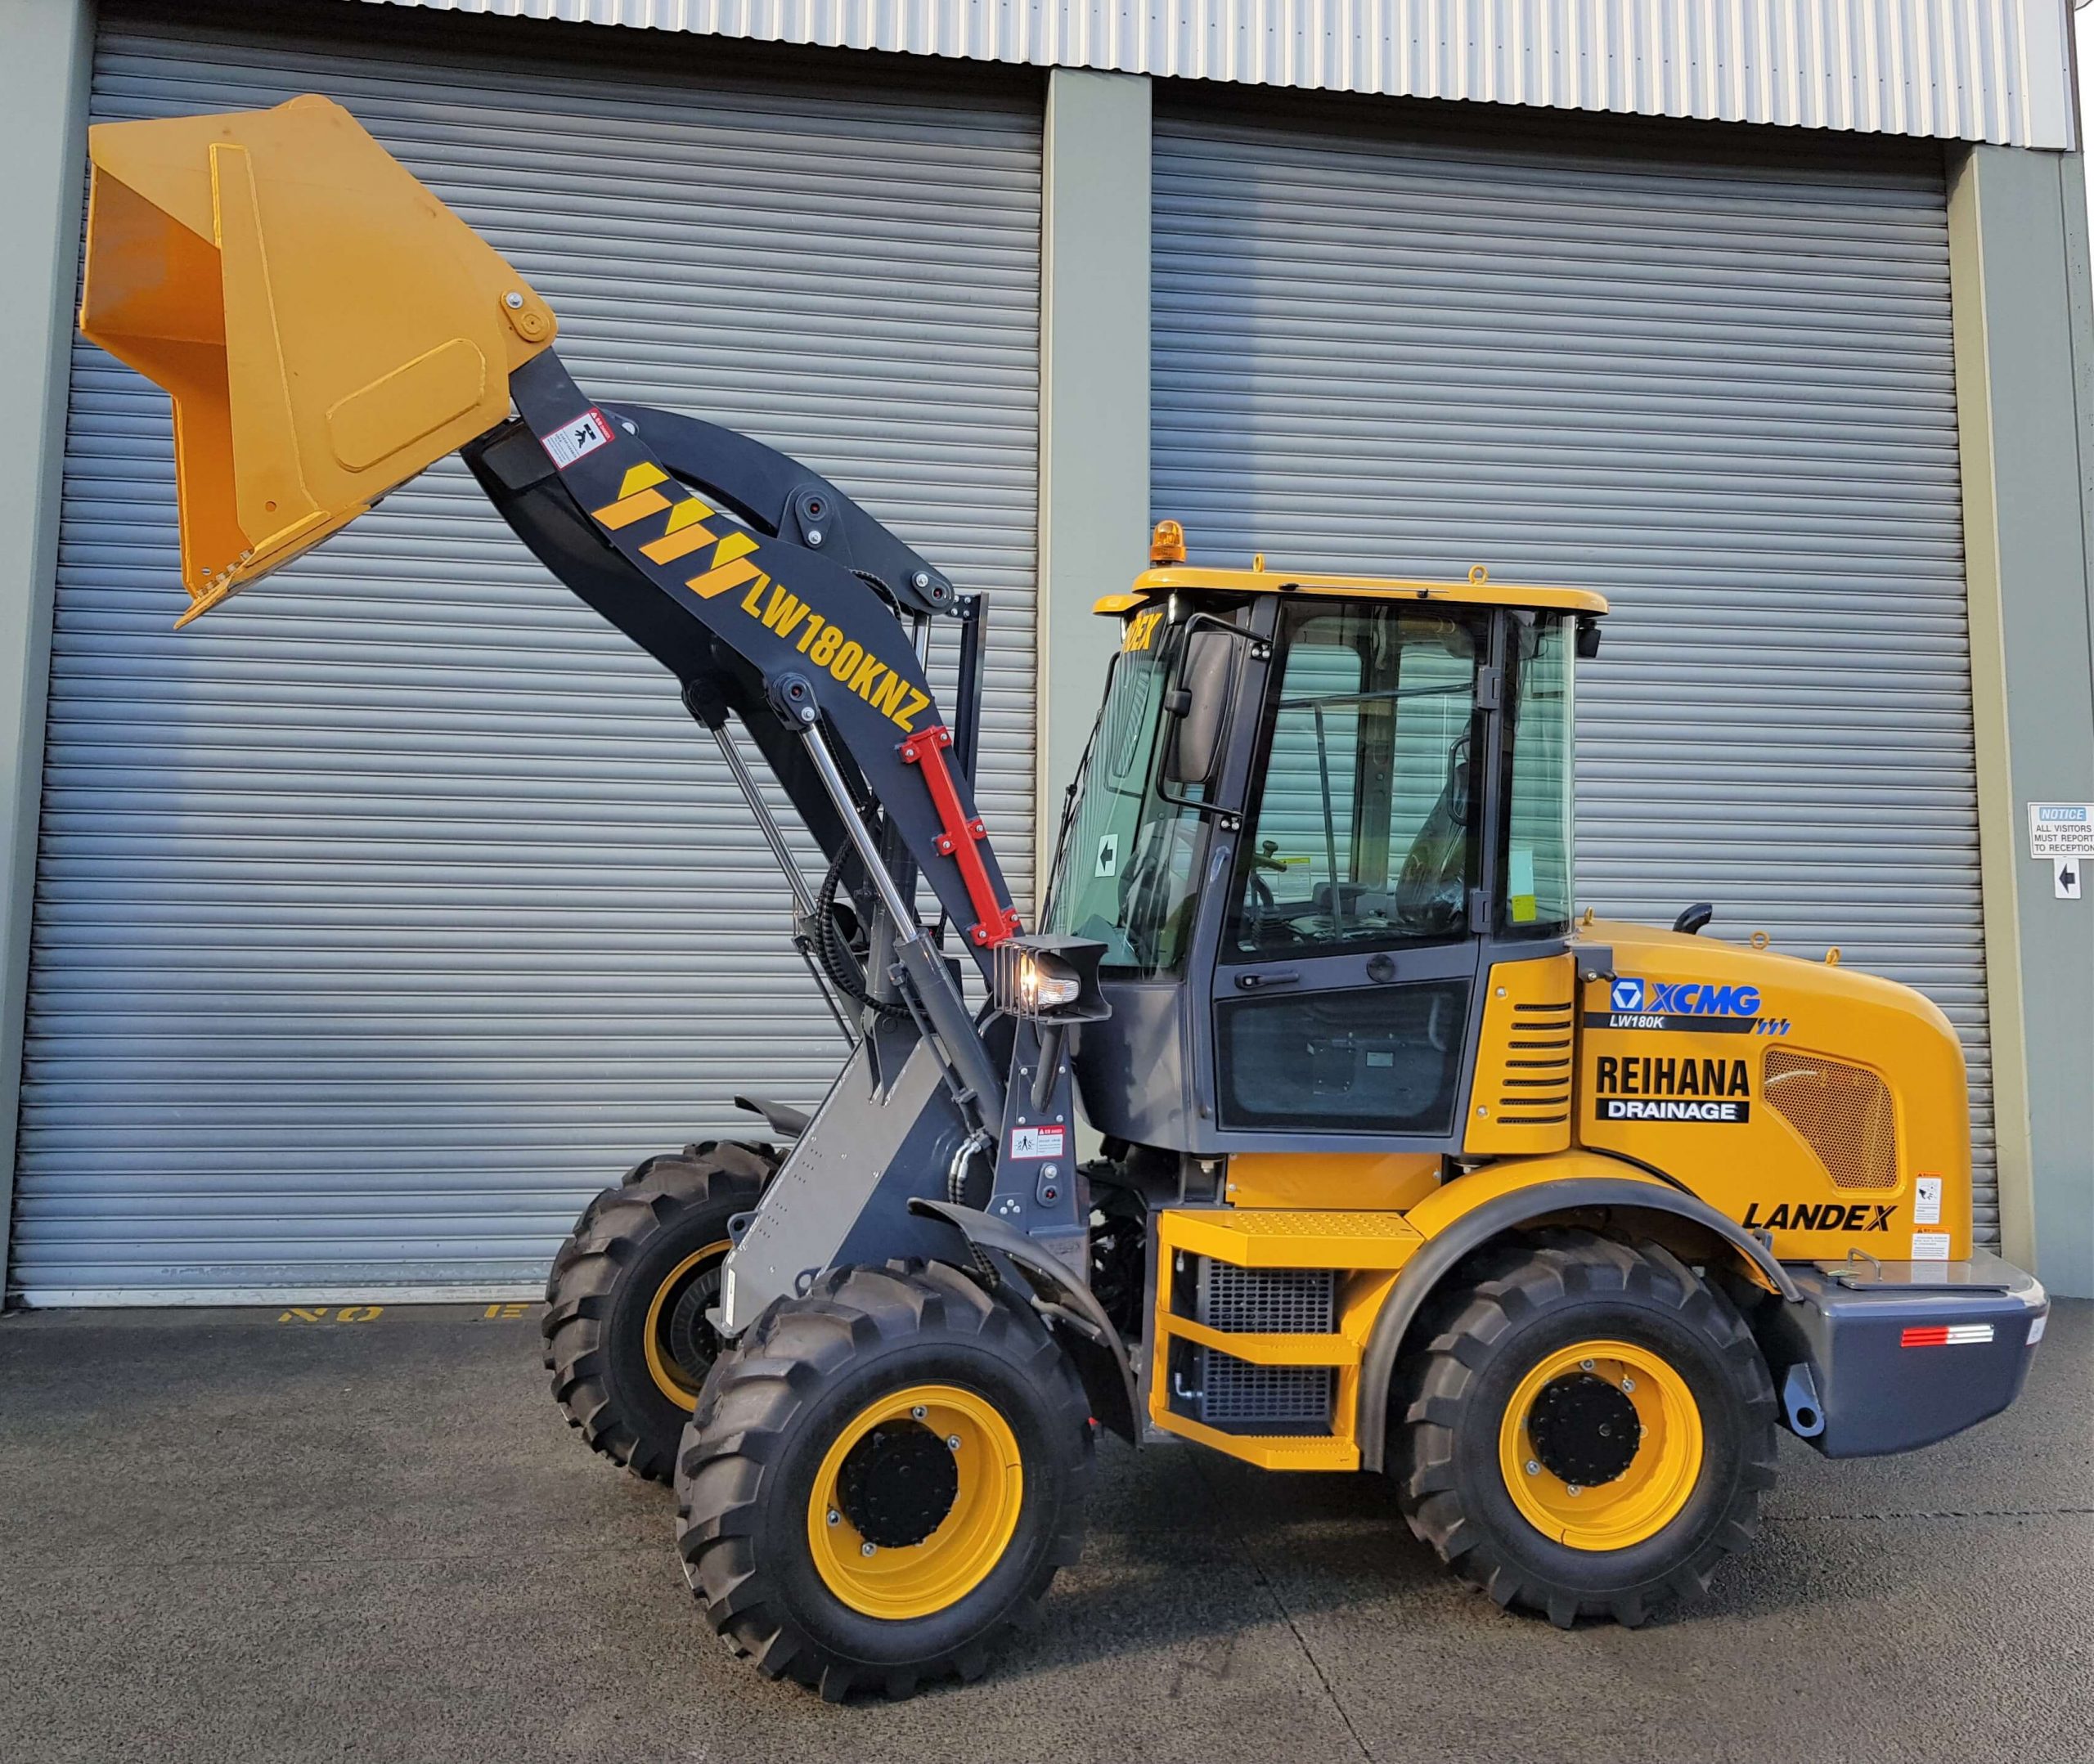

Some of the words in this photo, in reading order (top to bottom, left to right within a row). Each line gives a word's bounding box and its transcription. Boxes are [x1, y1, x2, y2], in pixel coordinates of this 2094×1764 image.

[740, 572, 931, 734] LW180KNZ
[2041, 808, 2085, 820] NOTICE
[2036, 824, 2051, 833] ALL
[2054, 824, 2092, 833] VISITORS
[2034, 834, 2058, 842] MUST
[2061, 834, 2094, 842] REPORT
[2049, 844, 2094, 852] RECEPTION
[1644, 983, 1761, 1016] XCMG
[1609, 1015, 1665, 1029] LW180K
[1596, 1056, 1750, 1097] REIHANA
[1607, 1101, 1737, 1120] DRAINAGE
[1741, 1203, 1899, 1232] LANDEX
[278, 1307, 384, 1322] NO
